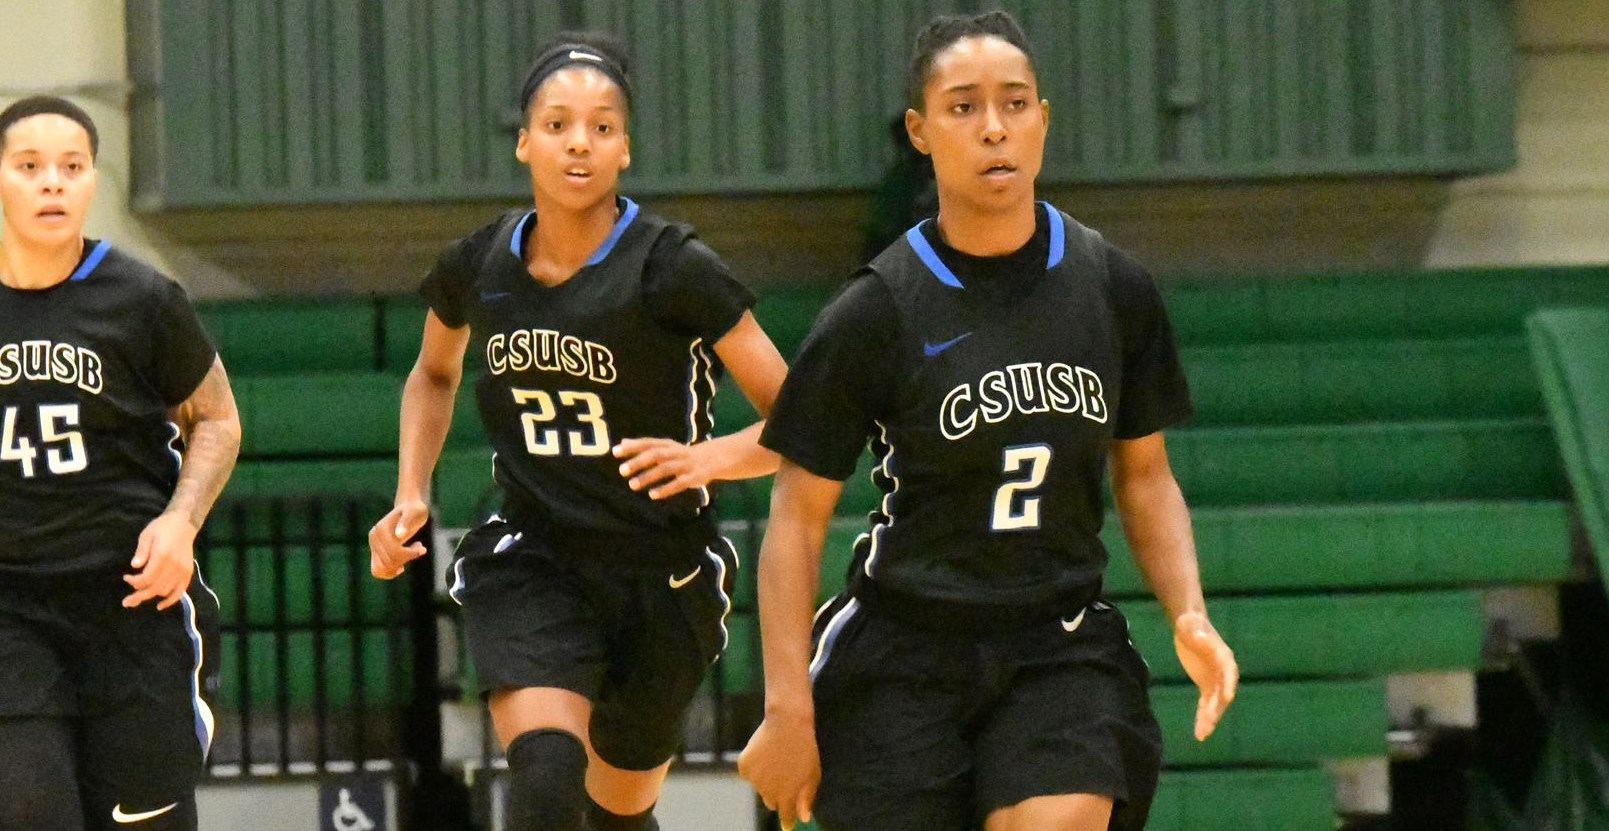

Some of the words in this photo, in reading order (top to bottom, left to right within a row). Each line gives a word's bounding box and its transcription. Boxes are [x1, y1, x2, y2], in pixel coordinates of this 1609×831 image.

[487, 329, 617, 384] CSUSB
[511, 387, 611, 456] 23
[939, 362, 1108, 440] CSUSB
[0, 403, 88, 478] 45
[991, 443, 1052, 530] 2
